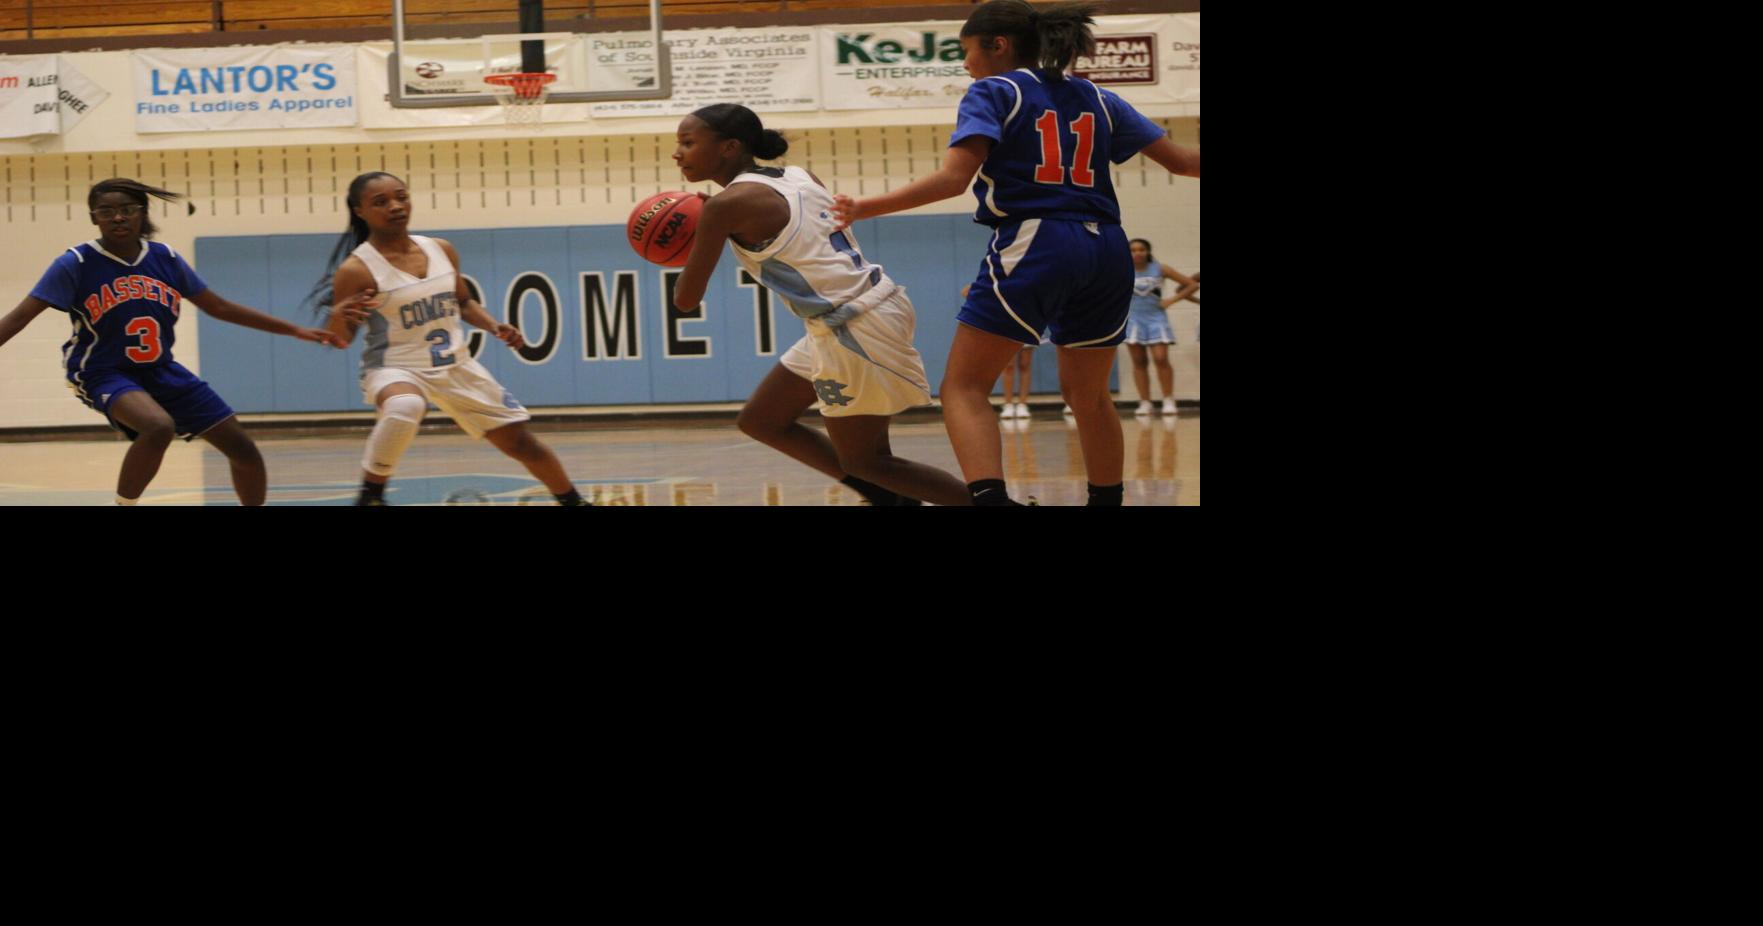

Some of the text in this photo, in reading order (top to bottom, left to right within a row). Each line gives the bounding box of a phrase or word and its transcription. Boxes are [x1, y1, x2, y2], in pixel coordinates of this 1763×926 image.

[593, 33, 811, 50] Pulmoary Associates
[598, 52, 618, 62] of
[725, 46, 806, 58] Virginia
[1095, 41, 1149, 54] FARM
[1074, 54, 1150, 69] BUREAU
[151, 63, 337, 96] LANTOR'S
[136, 95, 353, 114] Fine Ladies Apparel
[1034, 109, 1095, 188] 11
[631, 196, 675, 242] Wilson
[654, 211, 689, 248] NCAA
[84, 274, 182, 325] BASSETT
[125, 316, 162, 363] 3
[426, 328, 456, 367] 2
